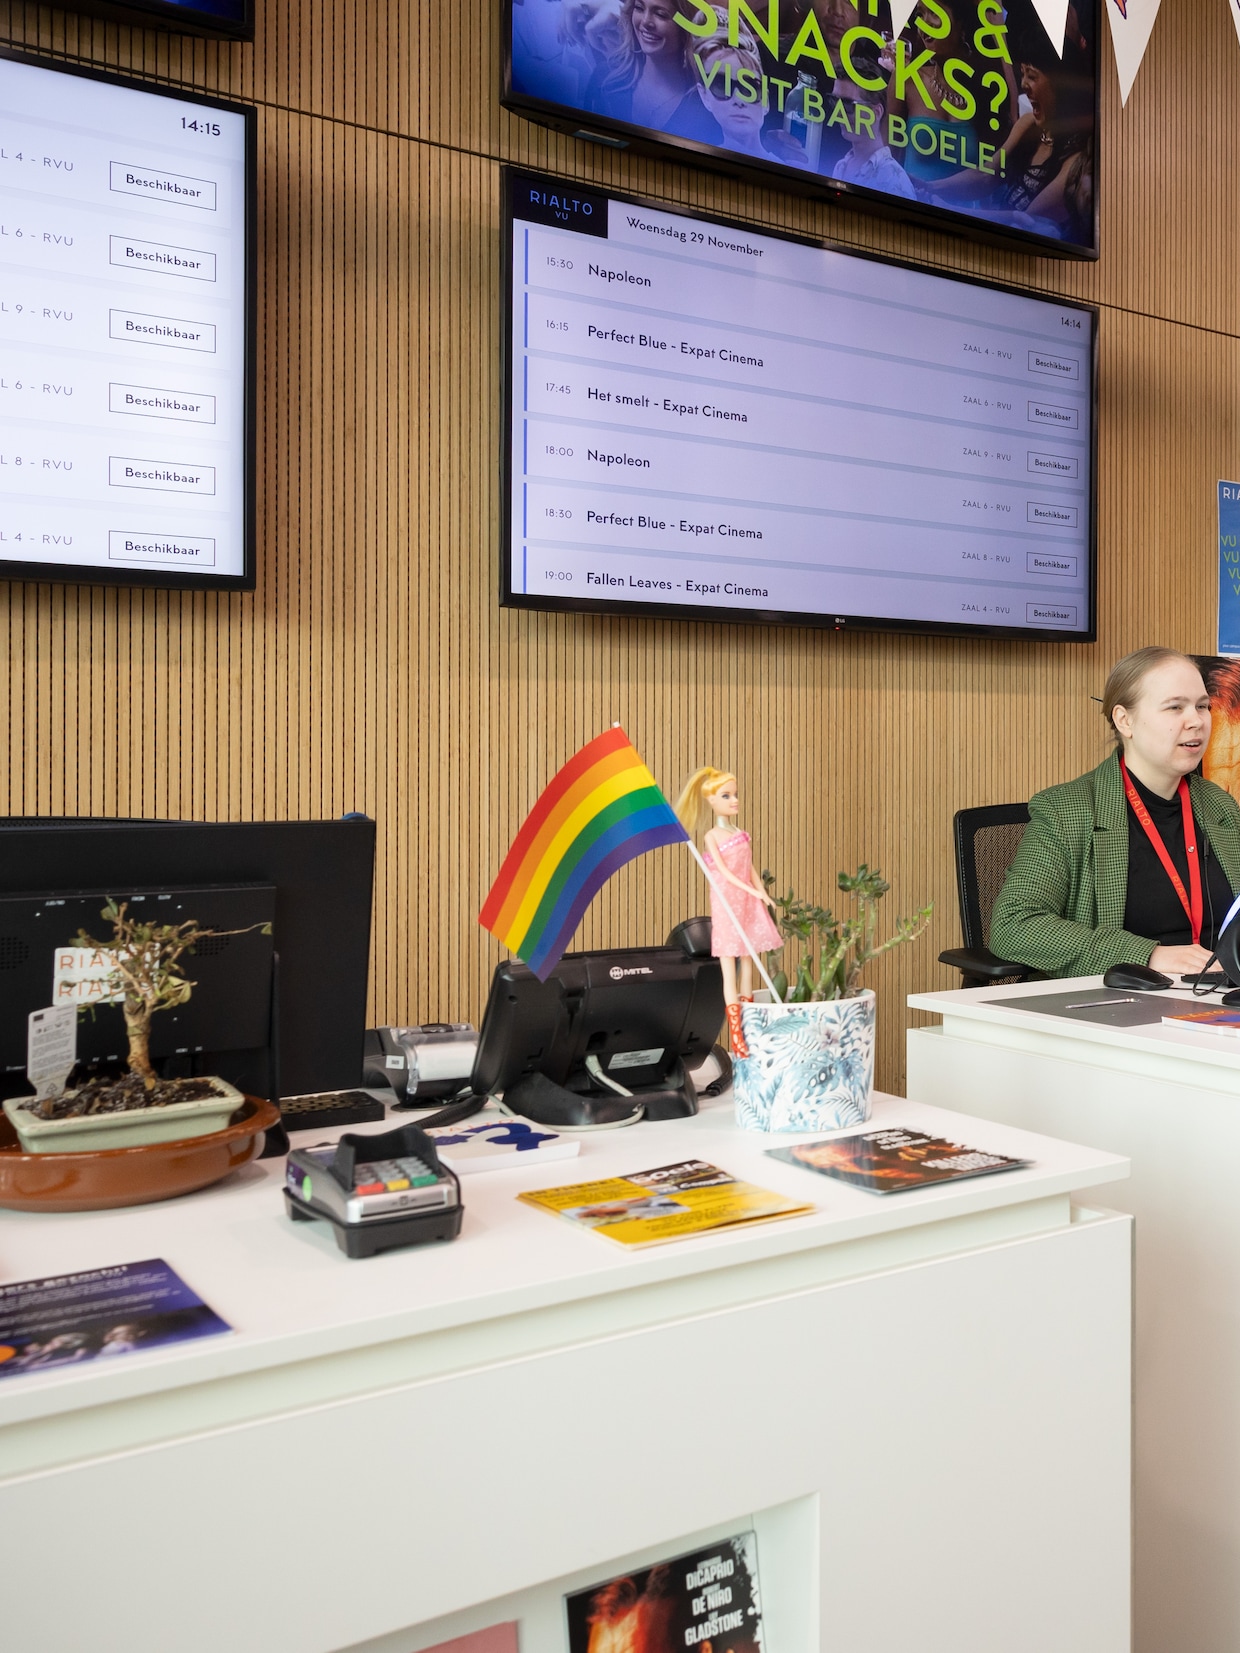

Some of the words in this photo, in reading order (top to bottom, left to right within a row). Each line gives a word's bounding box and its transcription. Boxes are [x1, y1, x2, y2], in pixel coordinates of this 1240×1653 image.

[673, 0, 1008, 131] SNACKS?
[693, 53, 792, 113] VISIT
[803, 86, 876, 140] BAR
[887, 114, 1006, 179] BOELE!
[182, 117, 220, 136] 14:15
[16, 153, 22, 161] 4
[44, 157, 73, 171] RVU
[126, 174, 202, 198] Beschikbaar
[529, 190, 593, 215] RIALTO
[555, 211, 568, 220] VU
[16, 229, 22, 237] 6
[44, 233, 73, 246] RVU
[627, 217, 686, 242] Woensdag
[691, 232, 704, 243] 29
[709, 236, 763, 256] November
[126, 247, 202, 270] Beschikbaar
[547, 257, 573, 269] 15:30
[589, 264, 650, 287] Napoleon
[16, 305, 23, 313] 9
[43, 308, 72, 321] RVU
[125, 320, 201, 341] Beschikbaar
[547, 320, 568, 331] 16:15
[1062, 317, 1080, 329] 14:14
[589, 326, 634, 344] Perfect
[640, 335, 666, 349] Blue
[681, 342, 715, 359] Expat
[719, 350, 763, 366] Cinema
[964, 344, 982, 353] ZAAL
[998, 351, 1012, 359] RVU
[1035, 359, 1071, 373] Beschikbaar
[15, 381, 22, 389] 6
[43, 384, 72, 396] RVU
[547, 383, 570, 394] 17:45
[125, 394, 201, 414] Beschikbaar
[588, 388, 611, 401] Het
[616, 396, 649, 407] smelt
[664, 399, 698, 415] Expat
[703, 406, 747, 422] Cinema
[964, 396, 982, 405] ZAAL
[997, 402, 1011, 410] RVU
[1035, 409, 1071, 422] Beschikbaar
[546, 446, 573, 456] 18:00
[588, 449, 649, 467] Napoleon
[963, 448, 981, 457] ZAAL
[997, 453, 1011, 461] RVU
[15, 457, 22, 465] 8
[43, 459, 72, 470] RVU
[1035, 459, 1071, 471] Beschikbaar
[125, 467, 200, 485] Beschikbaar
[546, 509, 572, 518] 18:30
[963, 500, 981, 508] ZAAL
[996, 504, 1010, 512] RVU
[1034, 510, 1070, 521] Beschikbaar
[588, 511, 633, 526] Perfect
[639, 516, 665, 529] Blue
[680, 521, 714, 536] Expat
[718, 525, 762, 538] Cinema
[15, 533, 21, 541] 4
[43, 535, 72, 545] RVU
[1221, 536, 1237, 547] VU
[125, 541, 200, 557] Beschikbaar
[962, 552, 980, 560] ZAAL
[996, 555, 1010, 563] RVU
[1034, 560, 1070, 570] Beschikbaar
[1223, 552, 1239, 563] VU
[546, 571, 572, 580] 19:00
[588, 573, 624, 586] Fallen
[630, 576, 671, 589] Leaves
[686, 580, 720, 595] Expat
[724, 583, 768, 596] Cinema
[1033, 610, 1070, 619] Beschikbaar
[1127, 789, 1150, 826] RIALTO
[624, 967, 653, 976] MITEL
[692, 1596, 706, 1616] DE
[707, 1586, 732, 1610] NIRO
[685, 1609, 743, 1646] GLADSTONE
